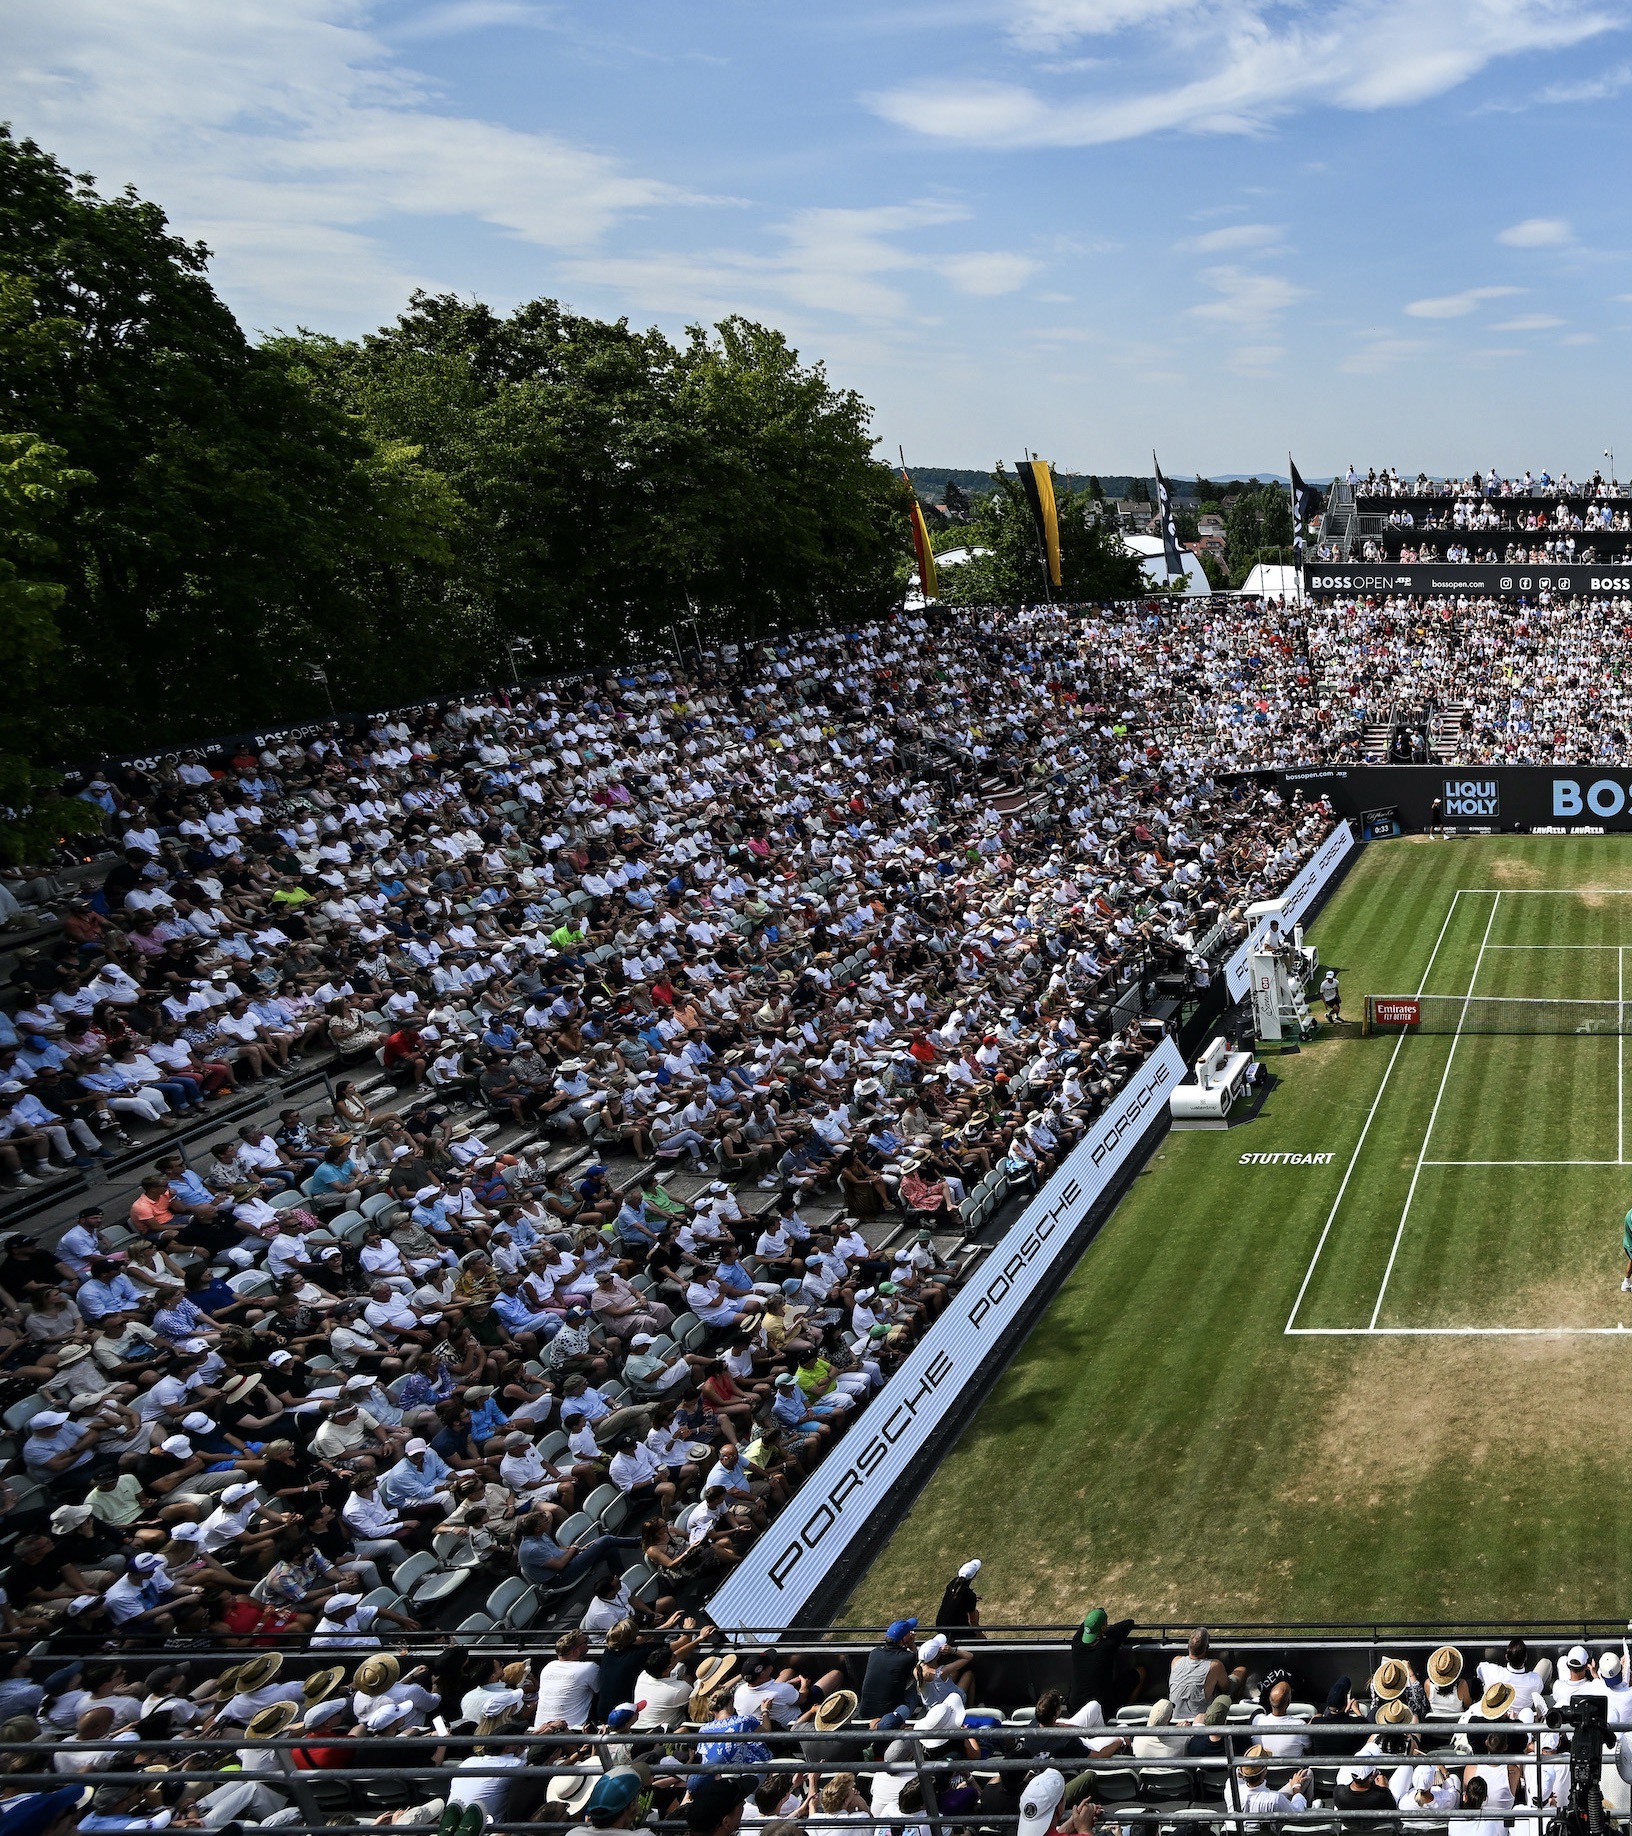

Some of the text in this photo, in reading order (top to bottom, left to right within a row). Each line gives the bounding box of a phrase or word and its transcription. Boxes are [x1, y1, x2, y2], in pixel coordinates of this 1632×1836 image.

[1312, 576, 1352, 590] BOSS
[1353, 577, 1393, 590] OPEN
[1432, 579, 1485, 590] bossopen.com
[1591, 578, 1630, 591] BOSS
[1285, 770, 1334, 781] bossopen.com
[1446, 781, 1496, 798] LIQUI
[1446, 799, 1498, 815] MOLY
[1374, 825, 1389, 834] 0:33
[1532, 826, 1604, 834] LAVAZZA LAVAZZA
[1319, 832, 1347, 872] PORSCHE
[1282, 871, 1317, 919] PORSCHE
[1377, 1004, 1417, 1014] Emirates
[1384, 1013, 1412, 1021] FLY BETTER
[1091, 1061, 1169, 1168] PORSCHE
[1238, 1152, 1336, 1164] STUTTGART
[968, 1179, 1082, 1330] PORSCHE
[767, 1349, 954, 1590] PORSCHE
